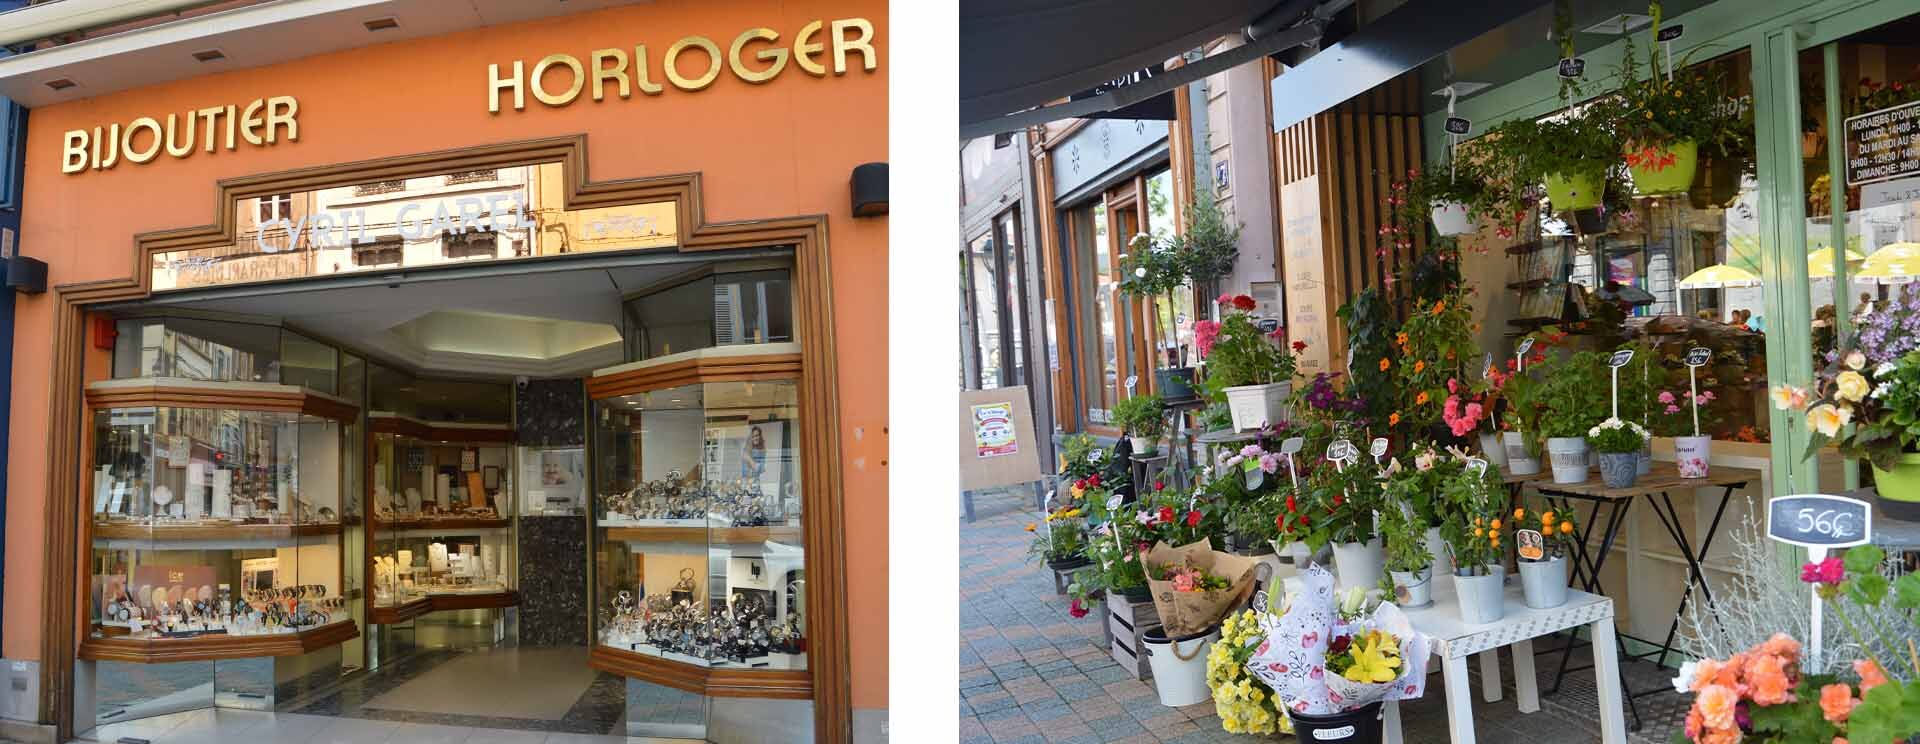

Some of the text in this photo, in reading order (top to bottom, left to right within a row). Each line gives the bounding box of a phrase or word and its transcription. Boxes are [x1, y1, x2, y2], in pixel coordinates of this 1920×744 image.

[487, 17, 878, 114] HORLOGER
[62, 95, 300, 174] BIJOUTIER
[1851, 113, 1890, 130] HORAIRES
[1850, 157, 1868, 169] 9H00
[1859, 144, 1870, 154] DU
[1871, 138, 1896, 152] MARDI
[1897, 134, 1909, 146] AU
[256, 209, 376, 254] CYRIL
[396, 192, 536, 241] GAREL
